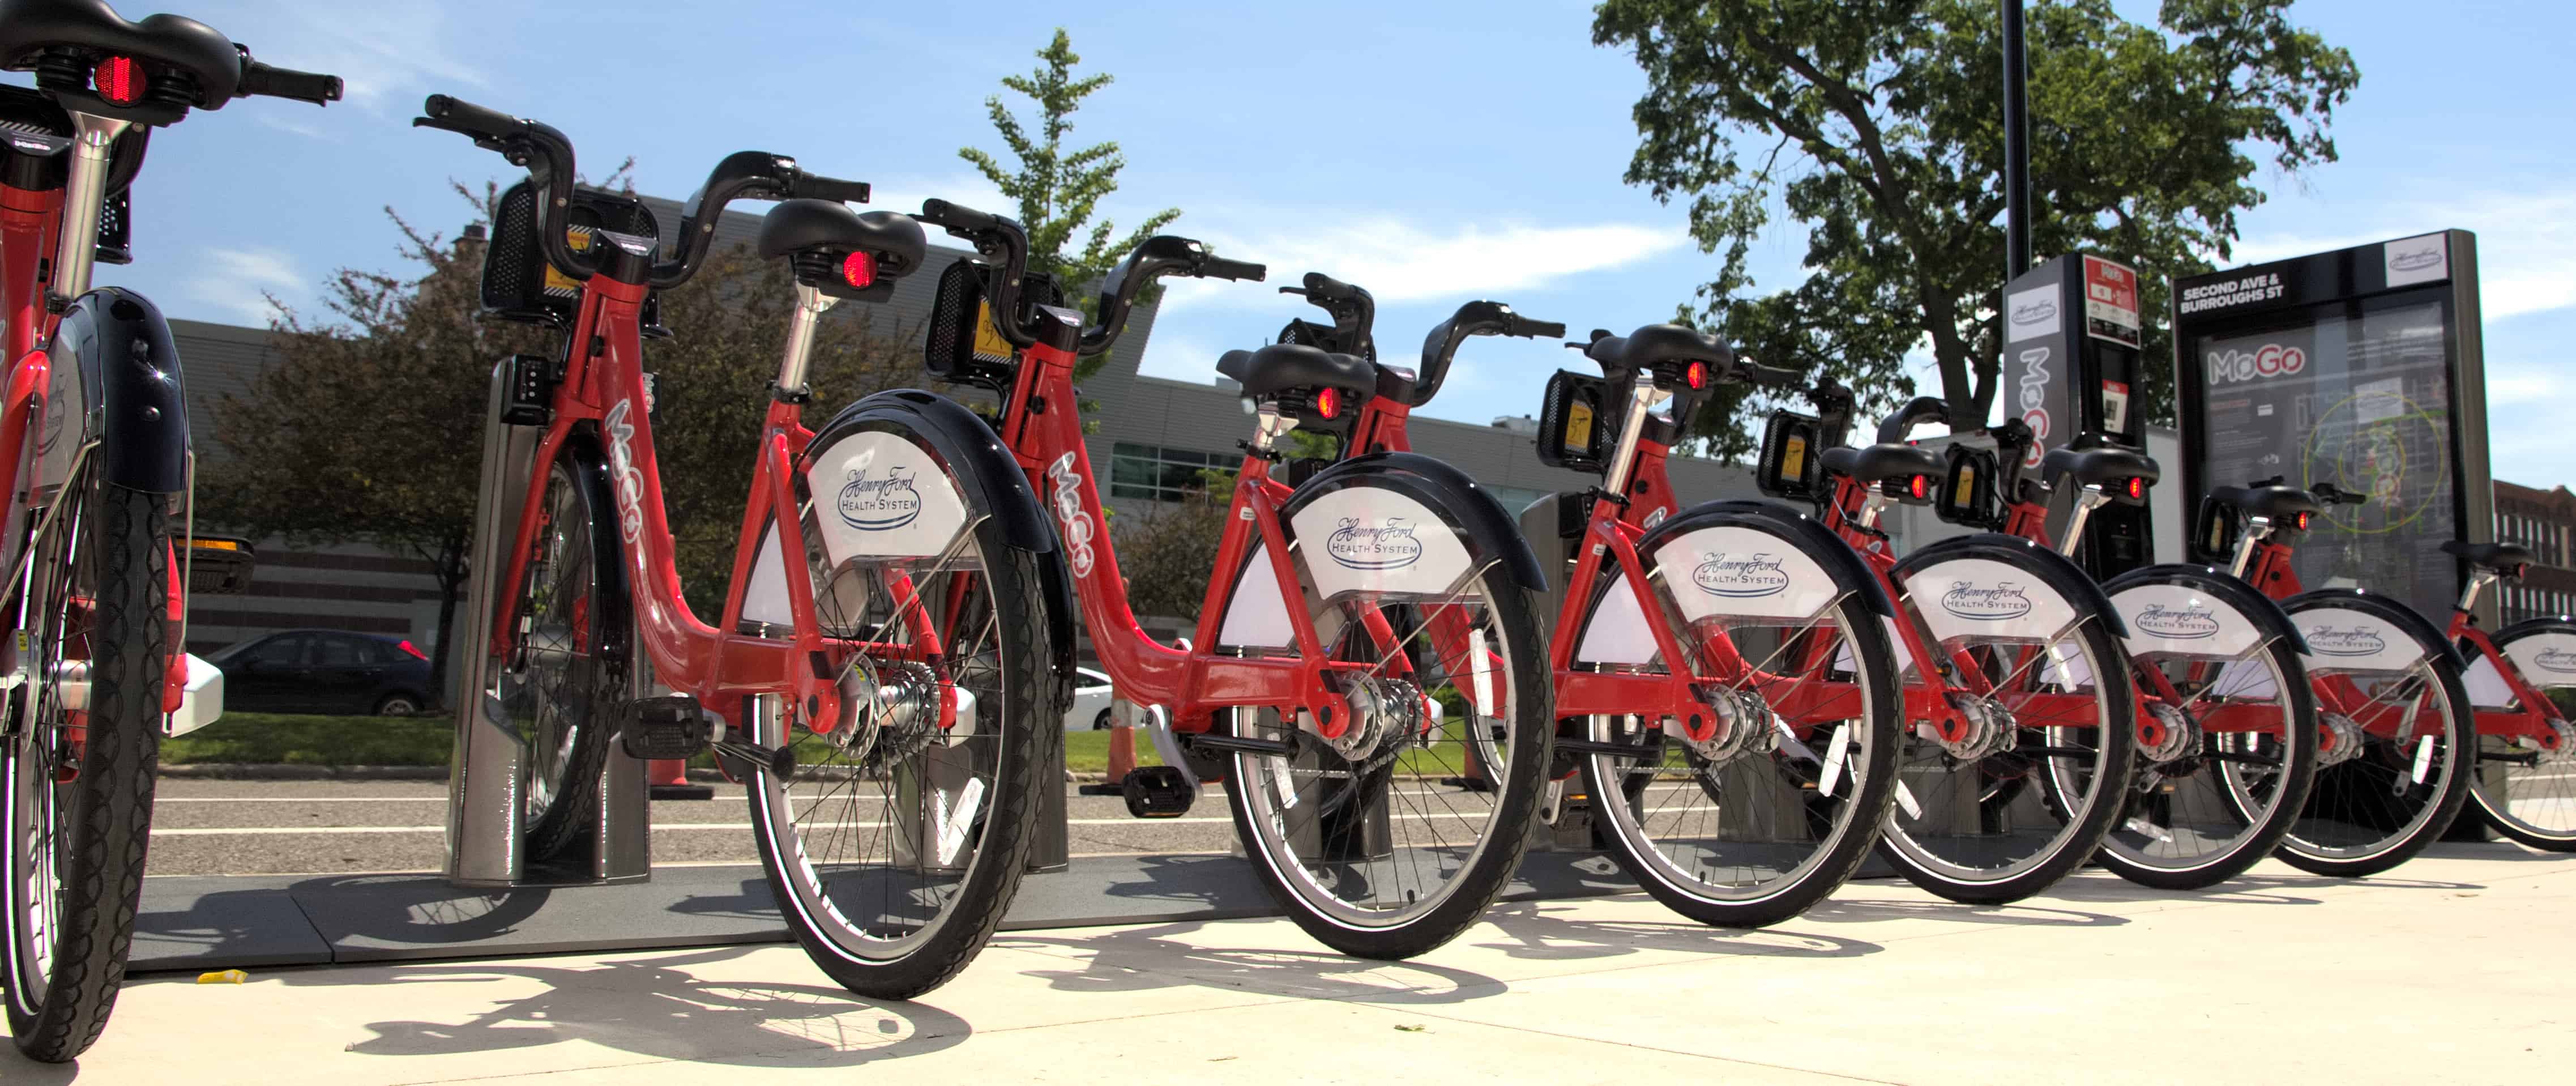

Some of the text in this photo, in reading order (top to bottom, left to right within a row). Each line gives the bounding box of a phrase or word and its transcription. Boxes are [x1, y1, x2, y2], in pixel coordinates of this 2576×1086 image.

[2183, 272, 2279, 301] SECOND AVE &
[2180, 285, 2284, 314] BURROUGHS ST
[2207, 343, 2306, 386] MoGo
[845, 466, 916, 501] Henry Ford
[842, 499, 917, 511] HEALTH SYSTEM
[1048, 450, 1095, 579] MoGo
[1336, 517, 1417, 546] Henry Ford
[1332, 543, 1417, 553] HEALTH SYSTEM
[1702, 552, 1783, 577] Henry Ford
[1698, 574, 1784, 585] HEALTH SYSTEM
[1950, 581, 2026, 603] Henry Ford
[1947, 600, 2027, 609] HEALTH SYSTEM
[2143, 603, 2214, 623] Henry Ford
